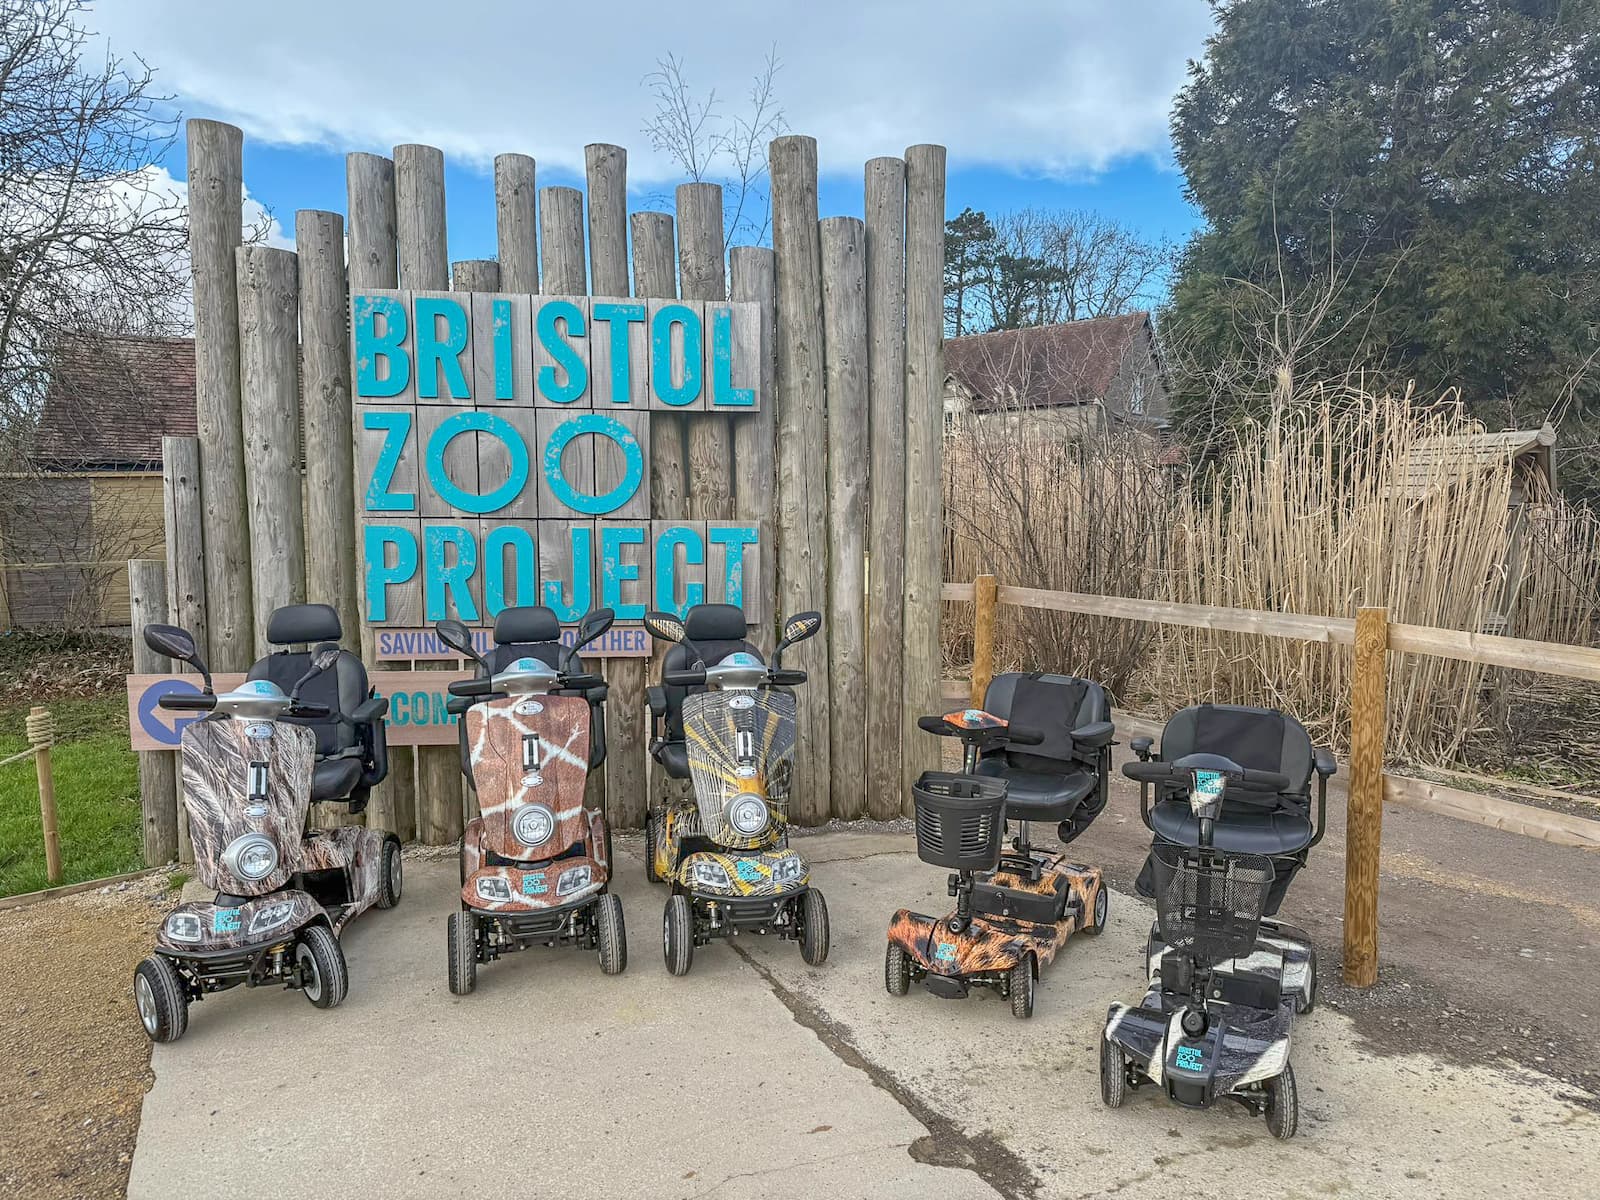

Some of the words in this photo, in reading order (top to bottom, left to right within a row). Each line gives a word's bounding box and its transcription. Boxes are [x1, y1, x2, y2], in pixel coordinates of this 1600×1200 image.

[353, 295, 755, 406] BRISTOL
[363, 410, 644, 515] ZOO
[363, 525, 759, 623] PROJECT
[1176, 1060, 1203, 1071] PROJECT
[1177, 1053, 1196, 1062] ZOO
[1178, 1045, 1202, 1058] BRISTOL
